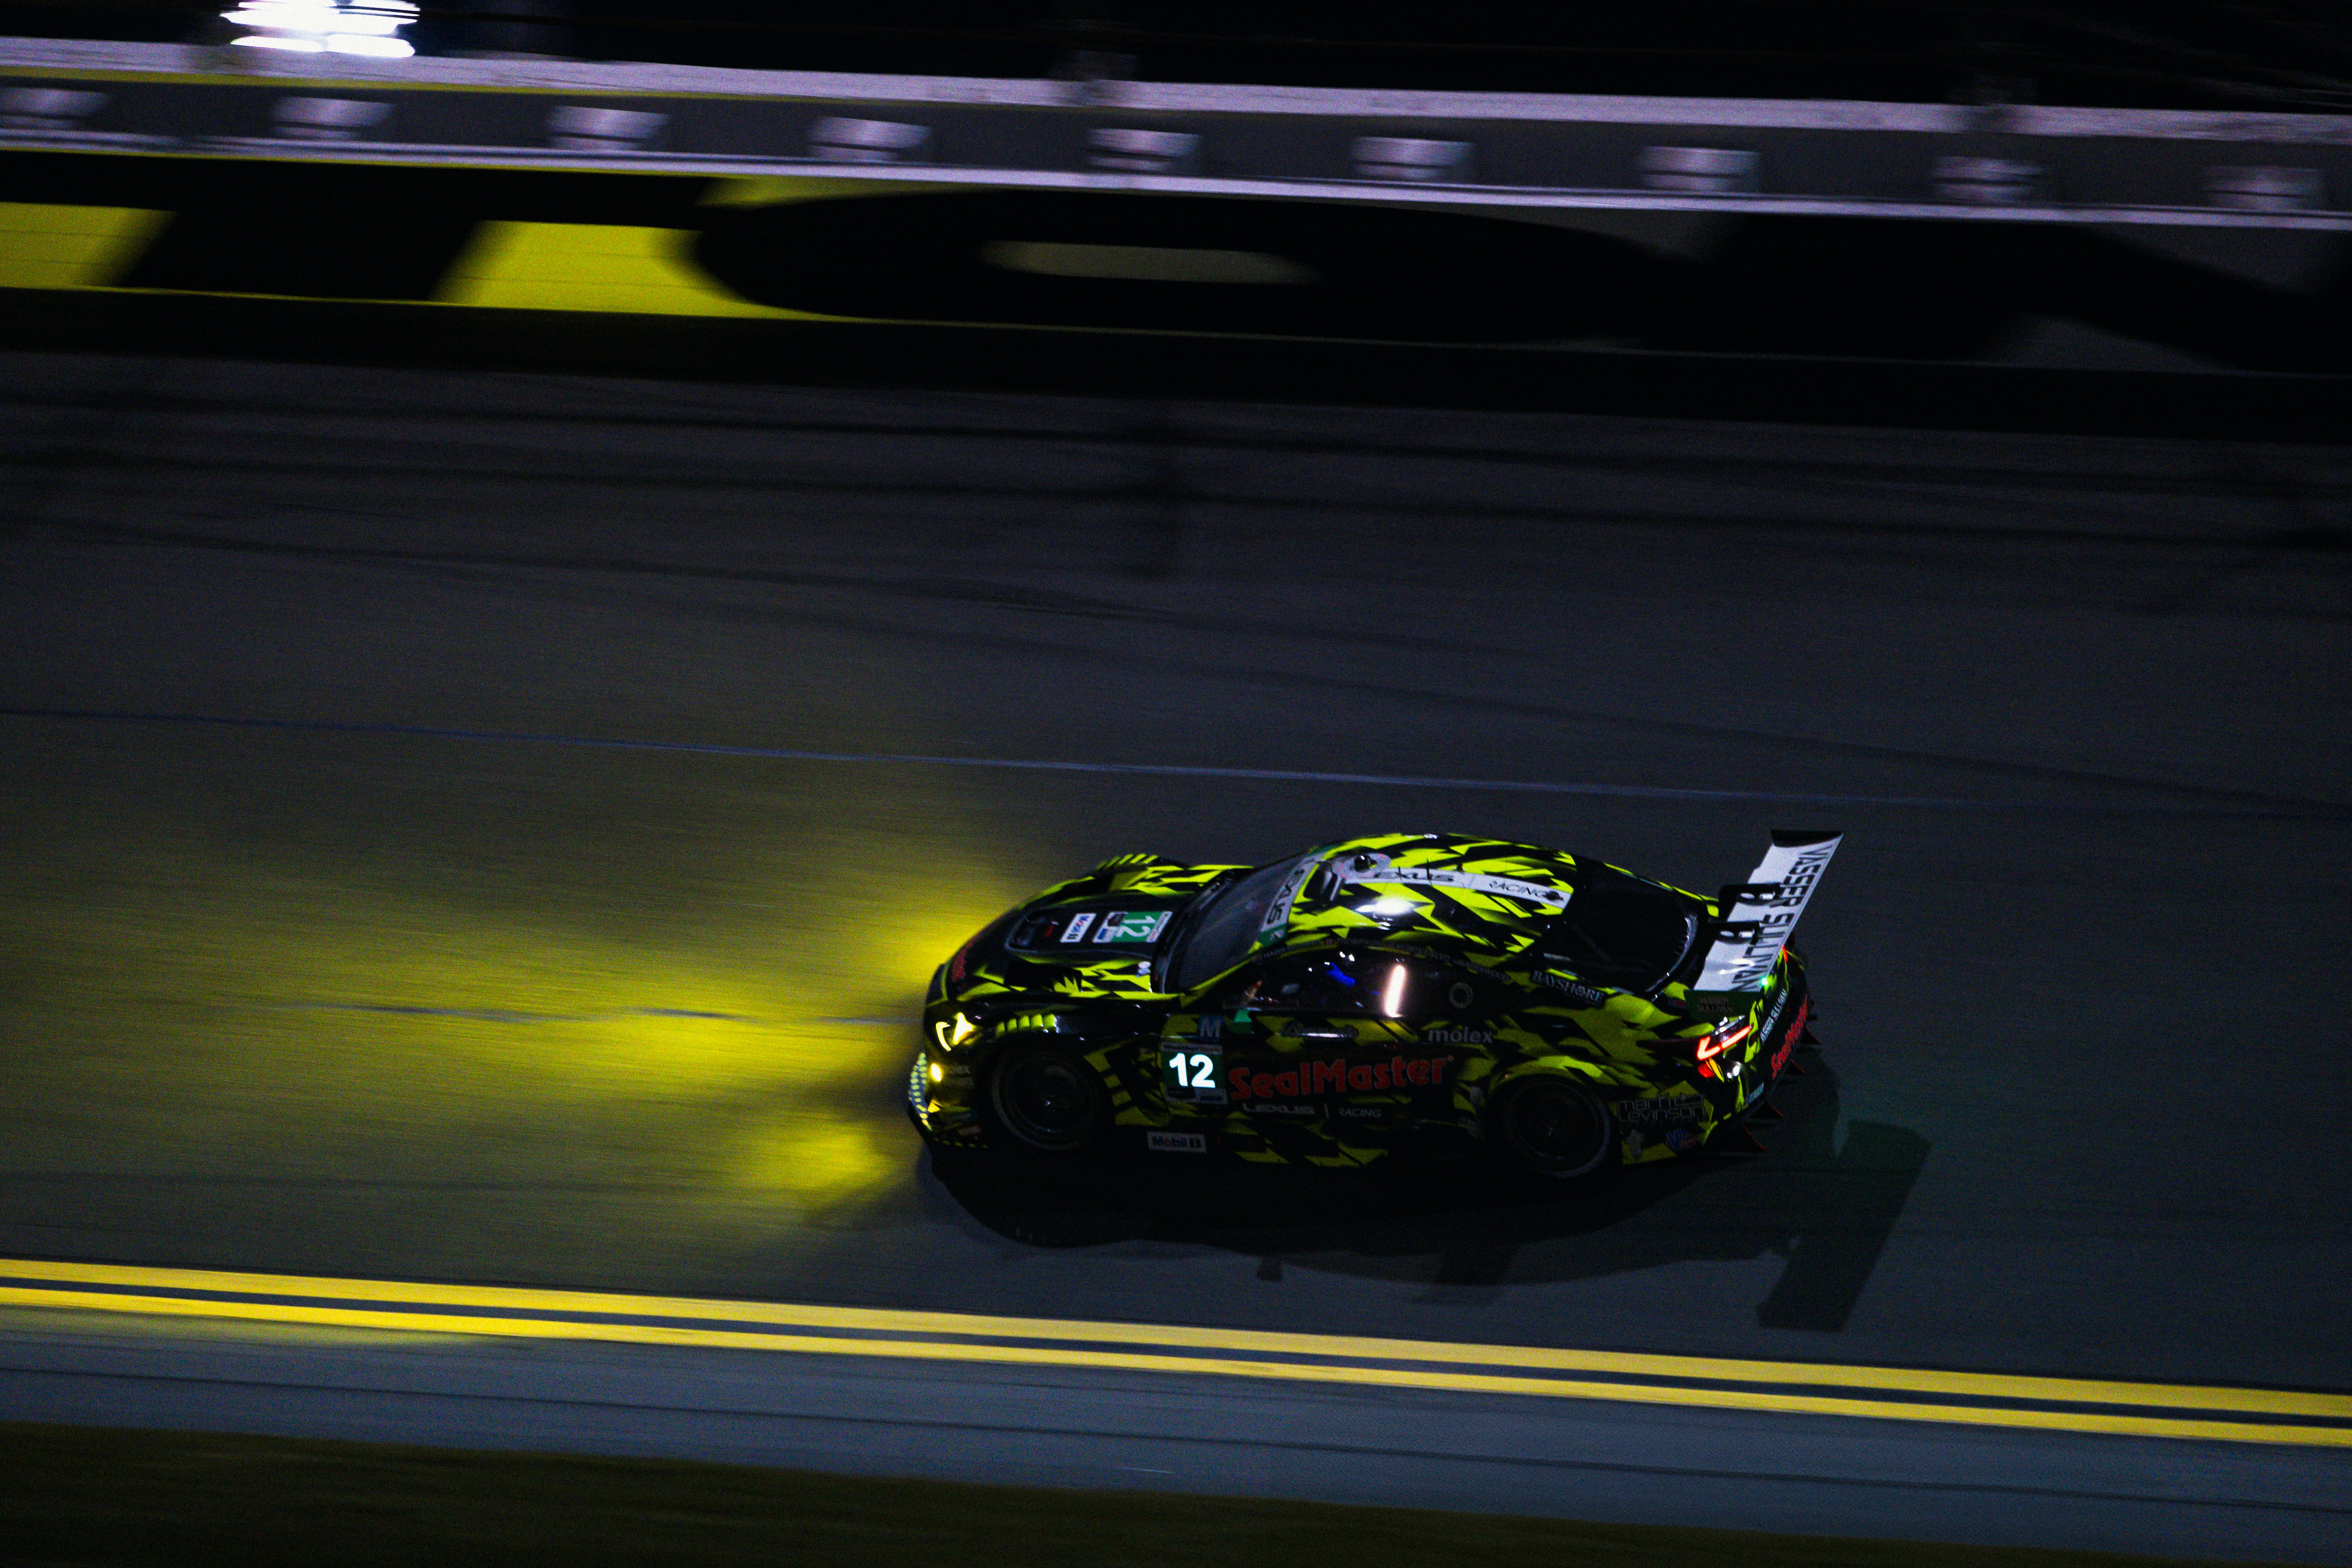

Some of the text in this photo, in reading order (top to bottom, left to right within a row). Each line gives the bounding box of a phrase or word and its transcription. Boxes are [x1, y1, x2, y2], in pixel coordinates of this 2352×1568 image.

[1116, 915, 1156, 937] 12
[1728, 845, 1833, 992] VASSER SULLIVAN
[1428, 1026, 1493, 1044] molex
[1169, 1052, 1216, 1088] 12
[1229, 1056, 1447, 1100] SealMaster
[1339, 1107, 1381, 1118] RACING
[1153, 1134, 1187, 1147] Mobil
[1666, 1129, 1687, 1149] VP
